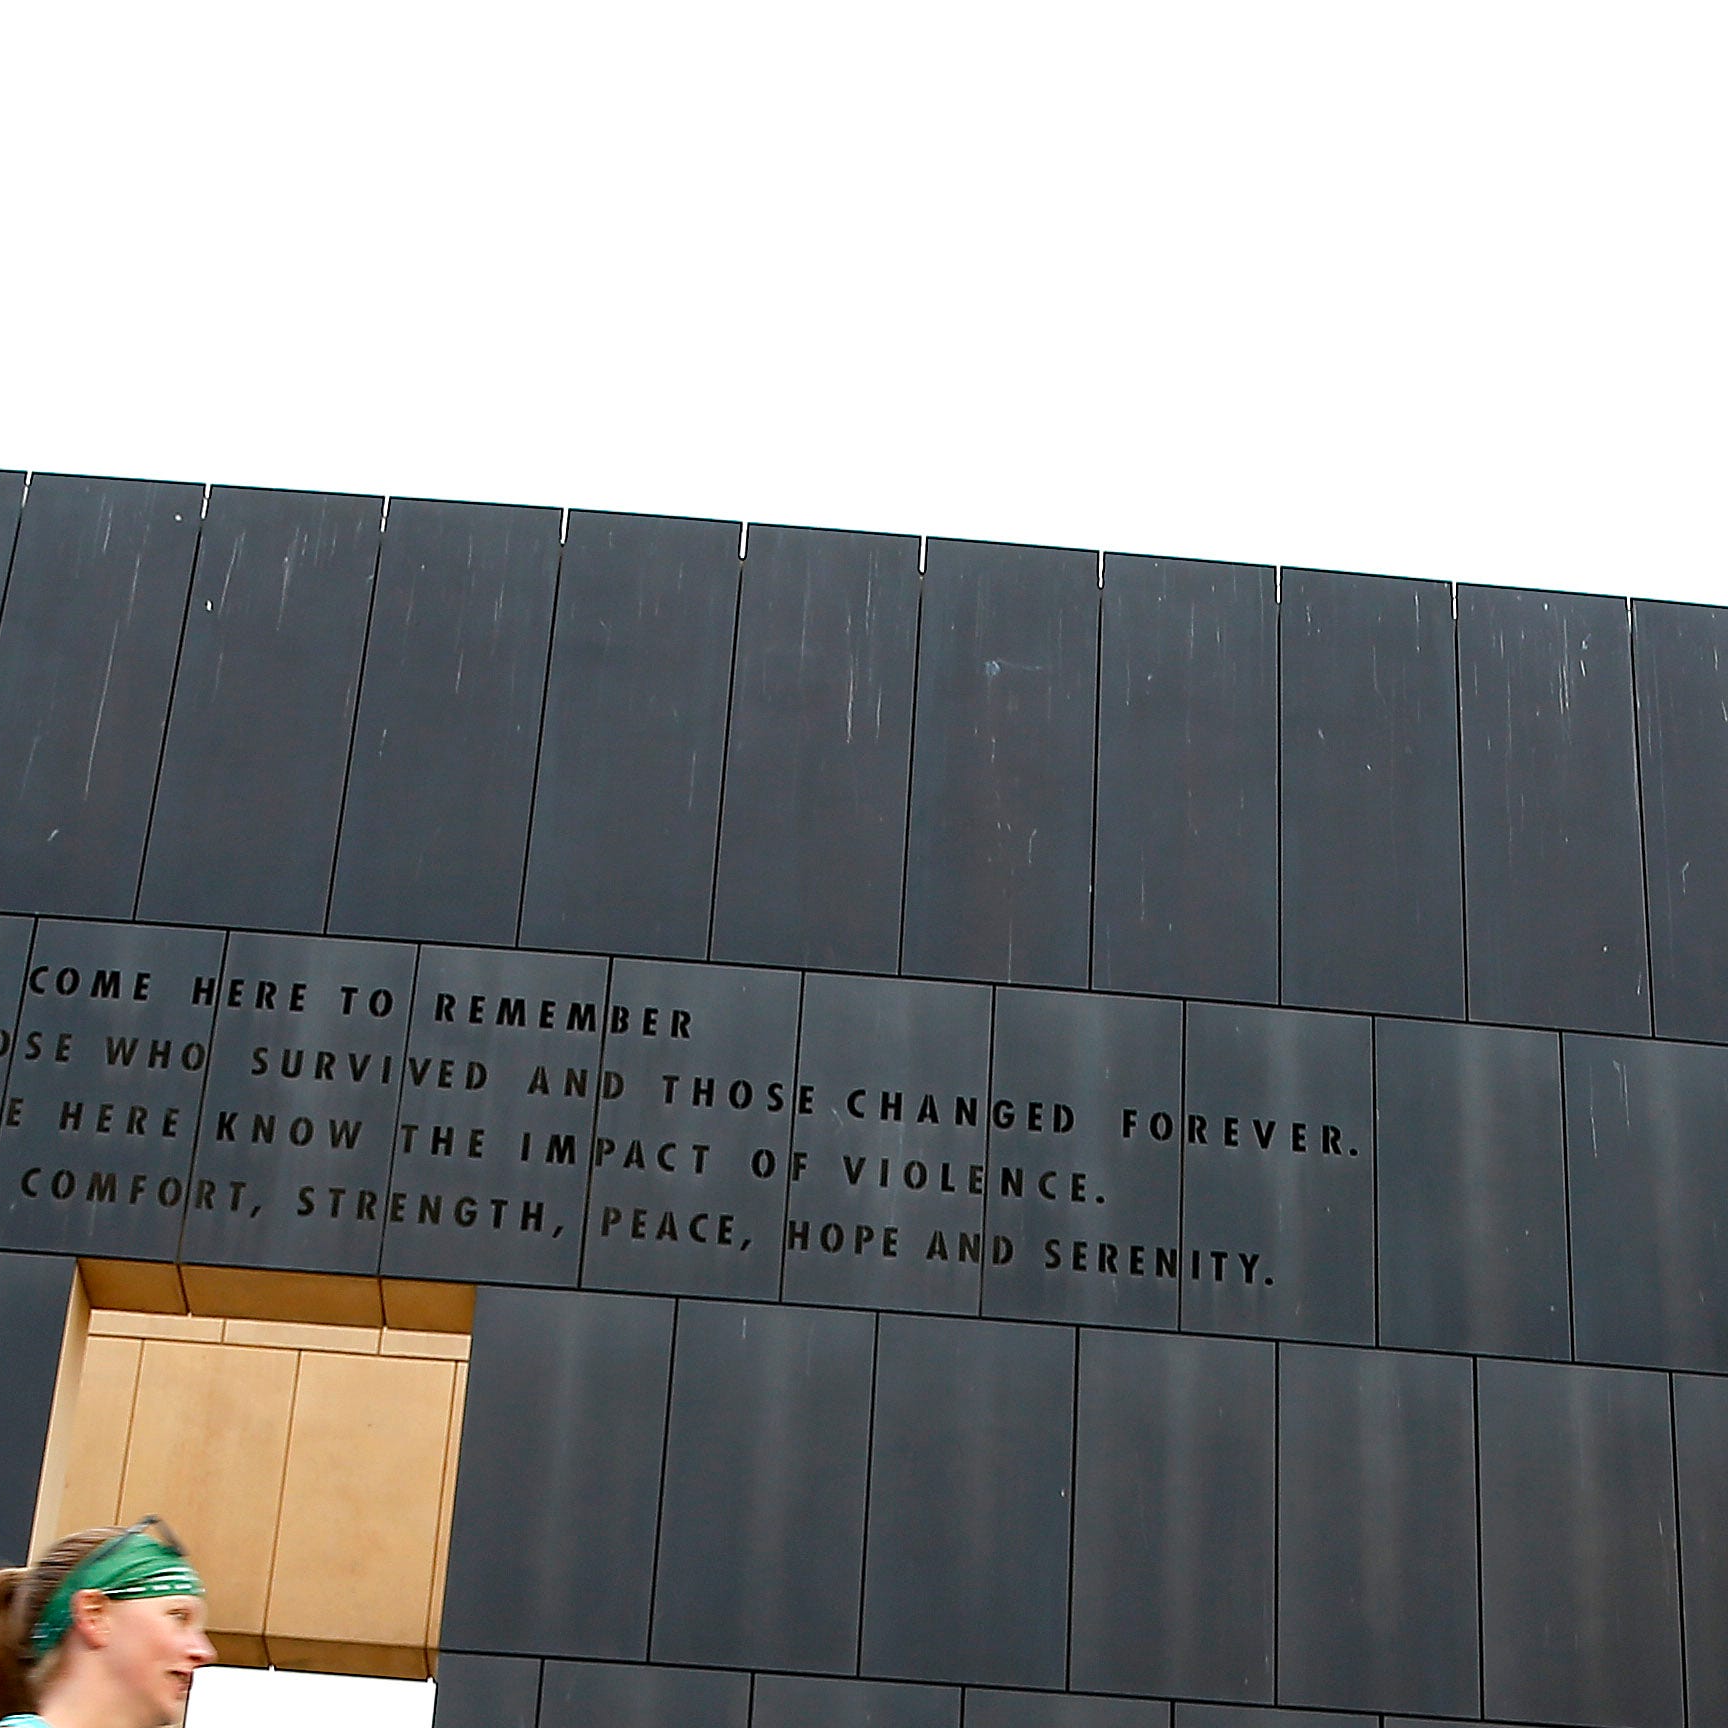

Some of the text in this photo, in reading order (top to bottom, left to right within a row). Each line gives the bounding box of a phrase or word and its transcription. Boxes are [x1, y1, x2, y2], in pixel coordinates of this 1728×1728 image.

[28, 964, 153, 1003] COME
[193, 974, 306, 1014] HERE
[342, 984, 394, 1019] TO
[434, 992, 694, 1039] REMEMBER
[59, 1099, 179, 1139] HERE
[217, 1110, 364, 1150] KNOW
[400, 1123, 486, 1161] THE
[521, 1130, 712, 1177] IMPACT
[750, 1146, 809, 1182] OF
[844, 1155, 1108, 1204] VIOLENCE.
[107, 1036, 207, 1074] WHO
[251, 1046, 488, 1090] SURVIVED
[528, 1064, 625, 1101] AND
[662, 1074, 815, 1116] THOSE
[847, 1087, 1075, 1135] CHANGED
[1122, 1108, 1361, 1159] FOREVER.
[21, 1166, 263, 1218] COMFORT,
[297, 1186, 567, 1240] STRENGTH,
[601, 1207, 754, 1252] PEACE,
[786, 1220, 899, 1258] HOPE
[927, 1227, 1014, 1267] AND
[1045, 1238, 1275, 1286] SERENITY.
